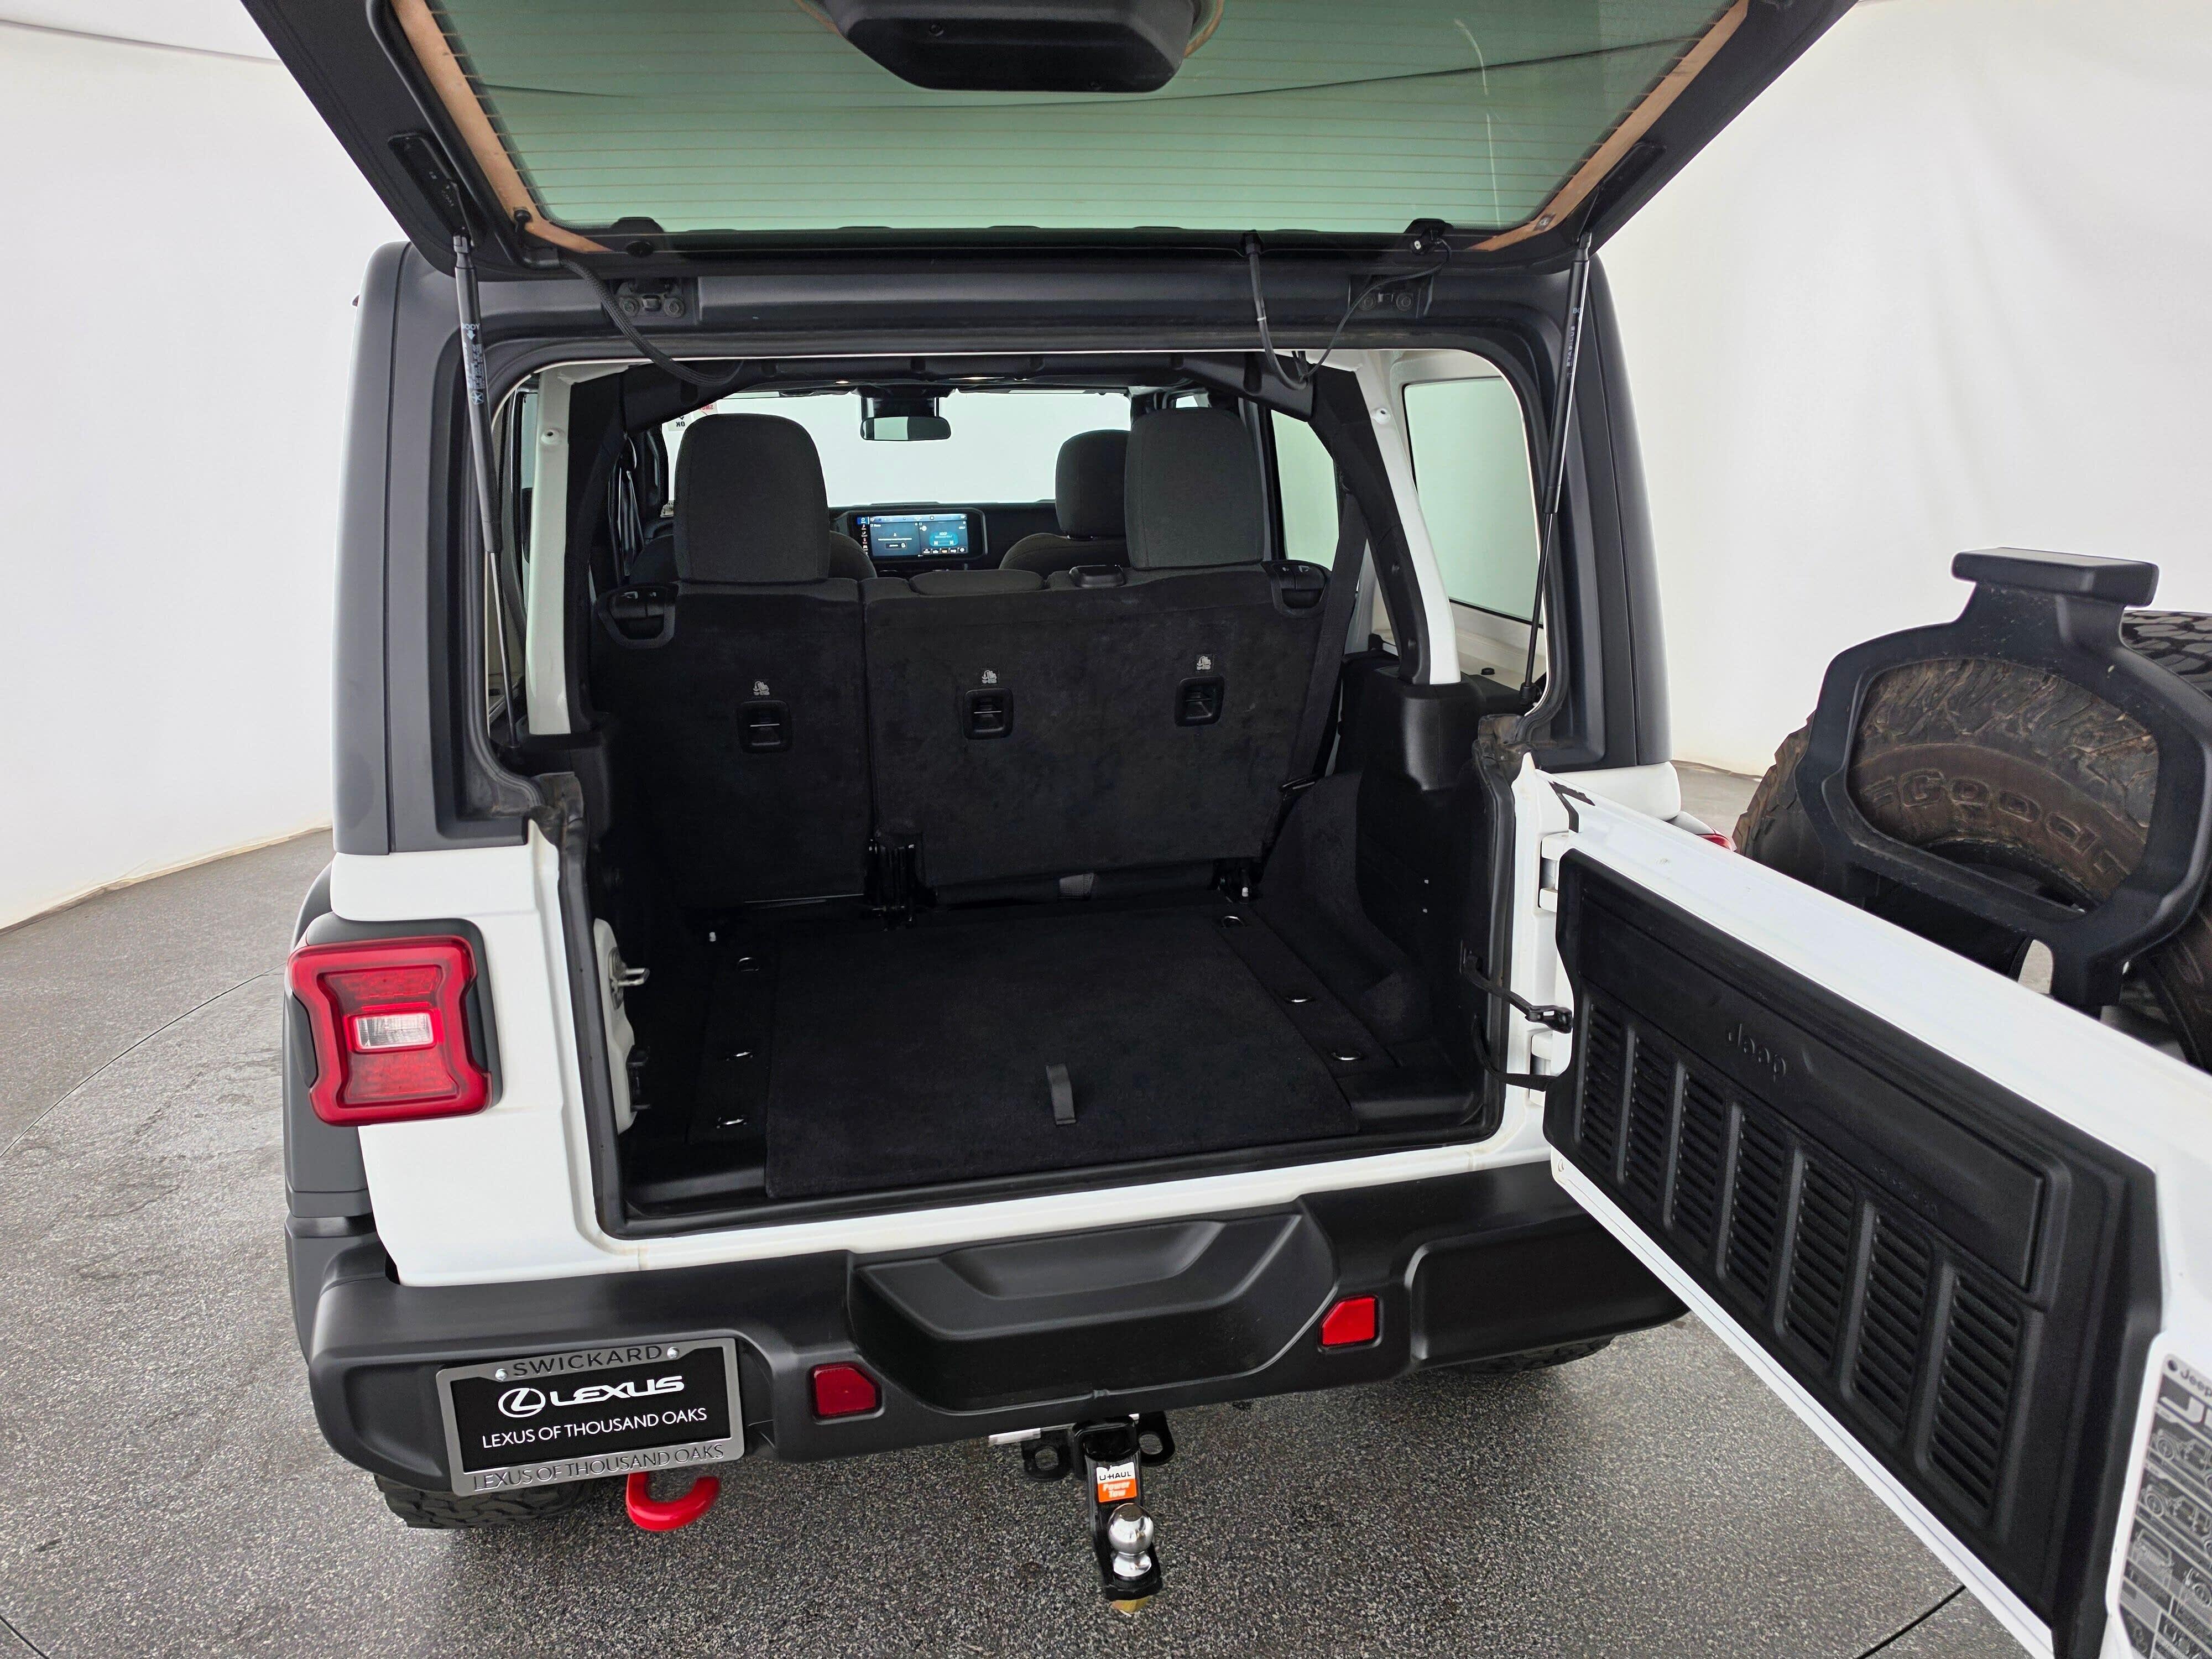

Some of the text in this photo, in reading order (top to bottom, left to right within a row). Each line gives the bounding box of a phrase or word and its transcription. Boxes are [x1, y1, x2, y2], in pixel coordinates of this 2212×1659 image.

[513, 1345, 662, 1377] SWICKARD
[550, 1375, 685, 1407] LEXUS
[482, 1407, 707, 1449] LEXUS OF THOUSAND OAKS
[473, 1443, 724, 1492] LEXUS OF THOUSAND OAKS
[1099, 1471, 1131, 1480] U-HAUL
